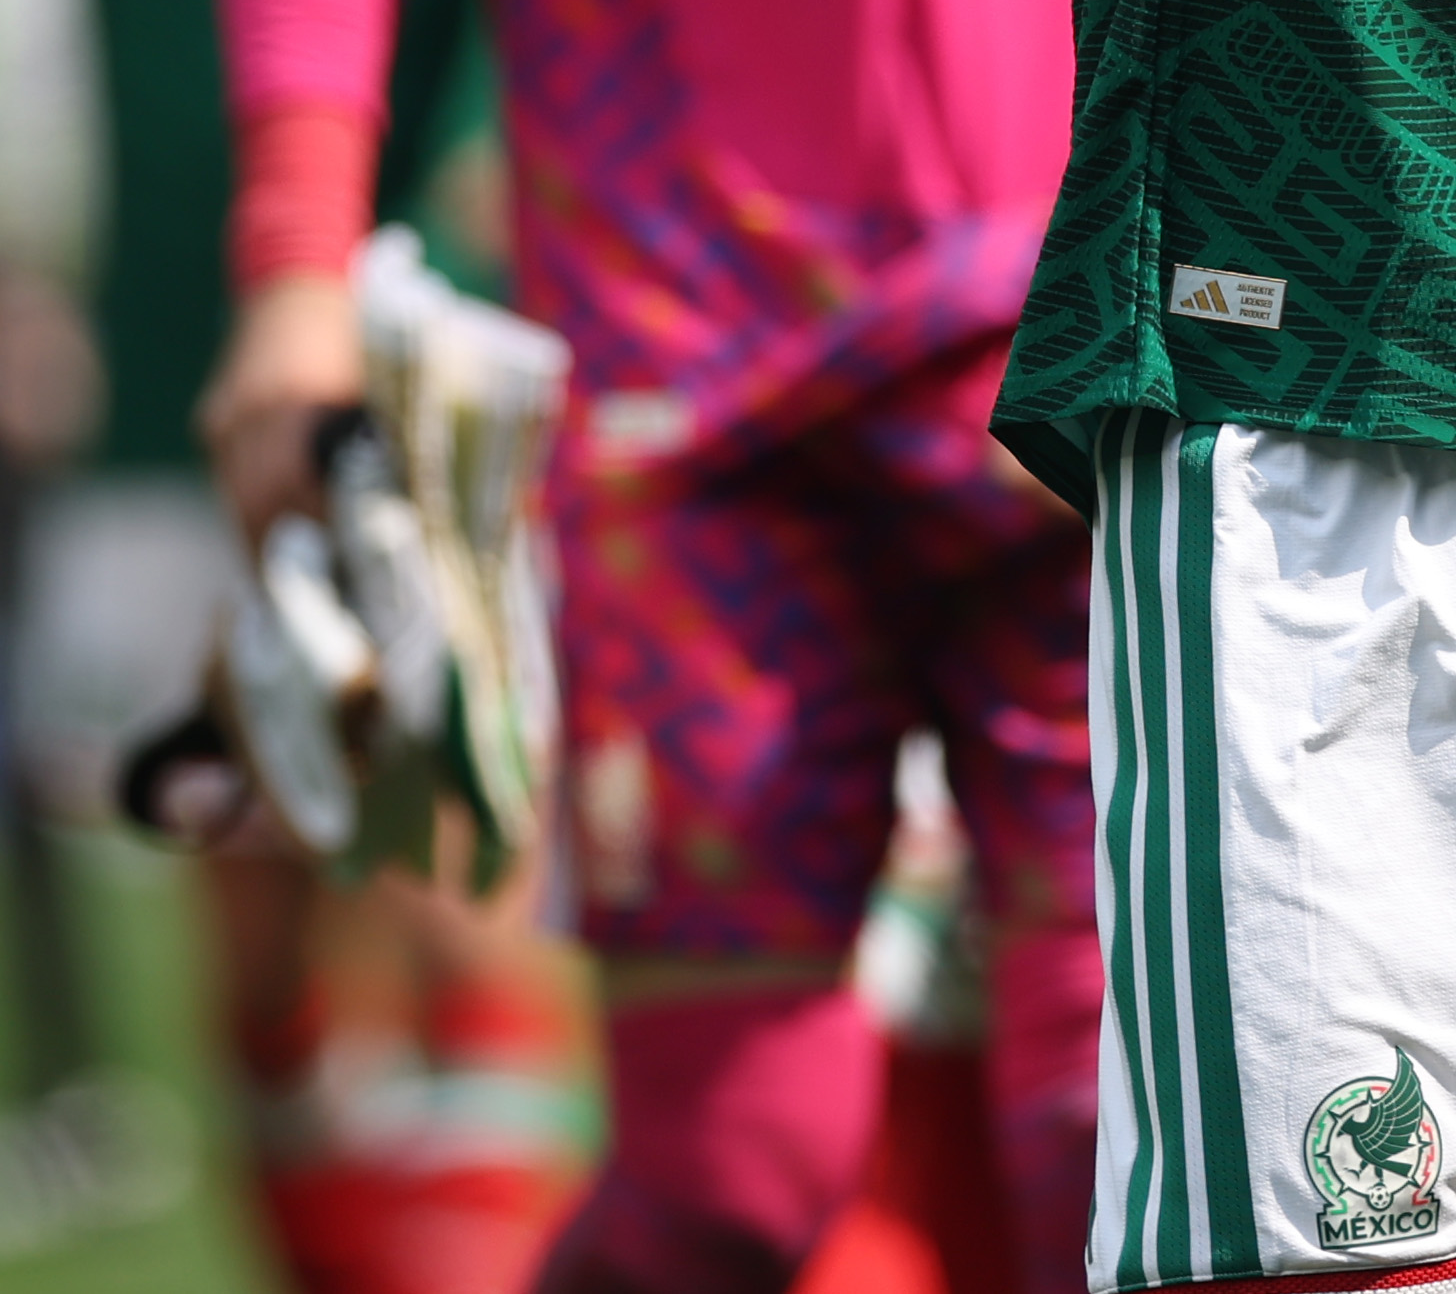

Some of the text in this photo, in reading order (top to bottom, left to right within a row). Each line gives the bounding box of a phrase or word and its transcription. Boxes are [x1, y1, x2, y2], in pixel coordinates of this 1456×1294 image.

[1237, 282, 1275, 297] AUTHENTIC
[1240, 296, 1273, 309] LICENSED
[1239, 309, 1271, 321] PRODUCT
[1323, 1210, 1433, 1242] MÉXICO
